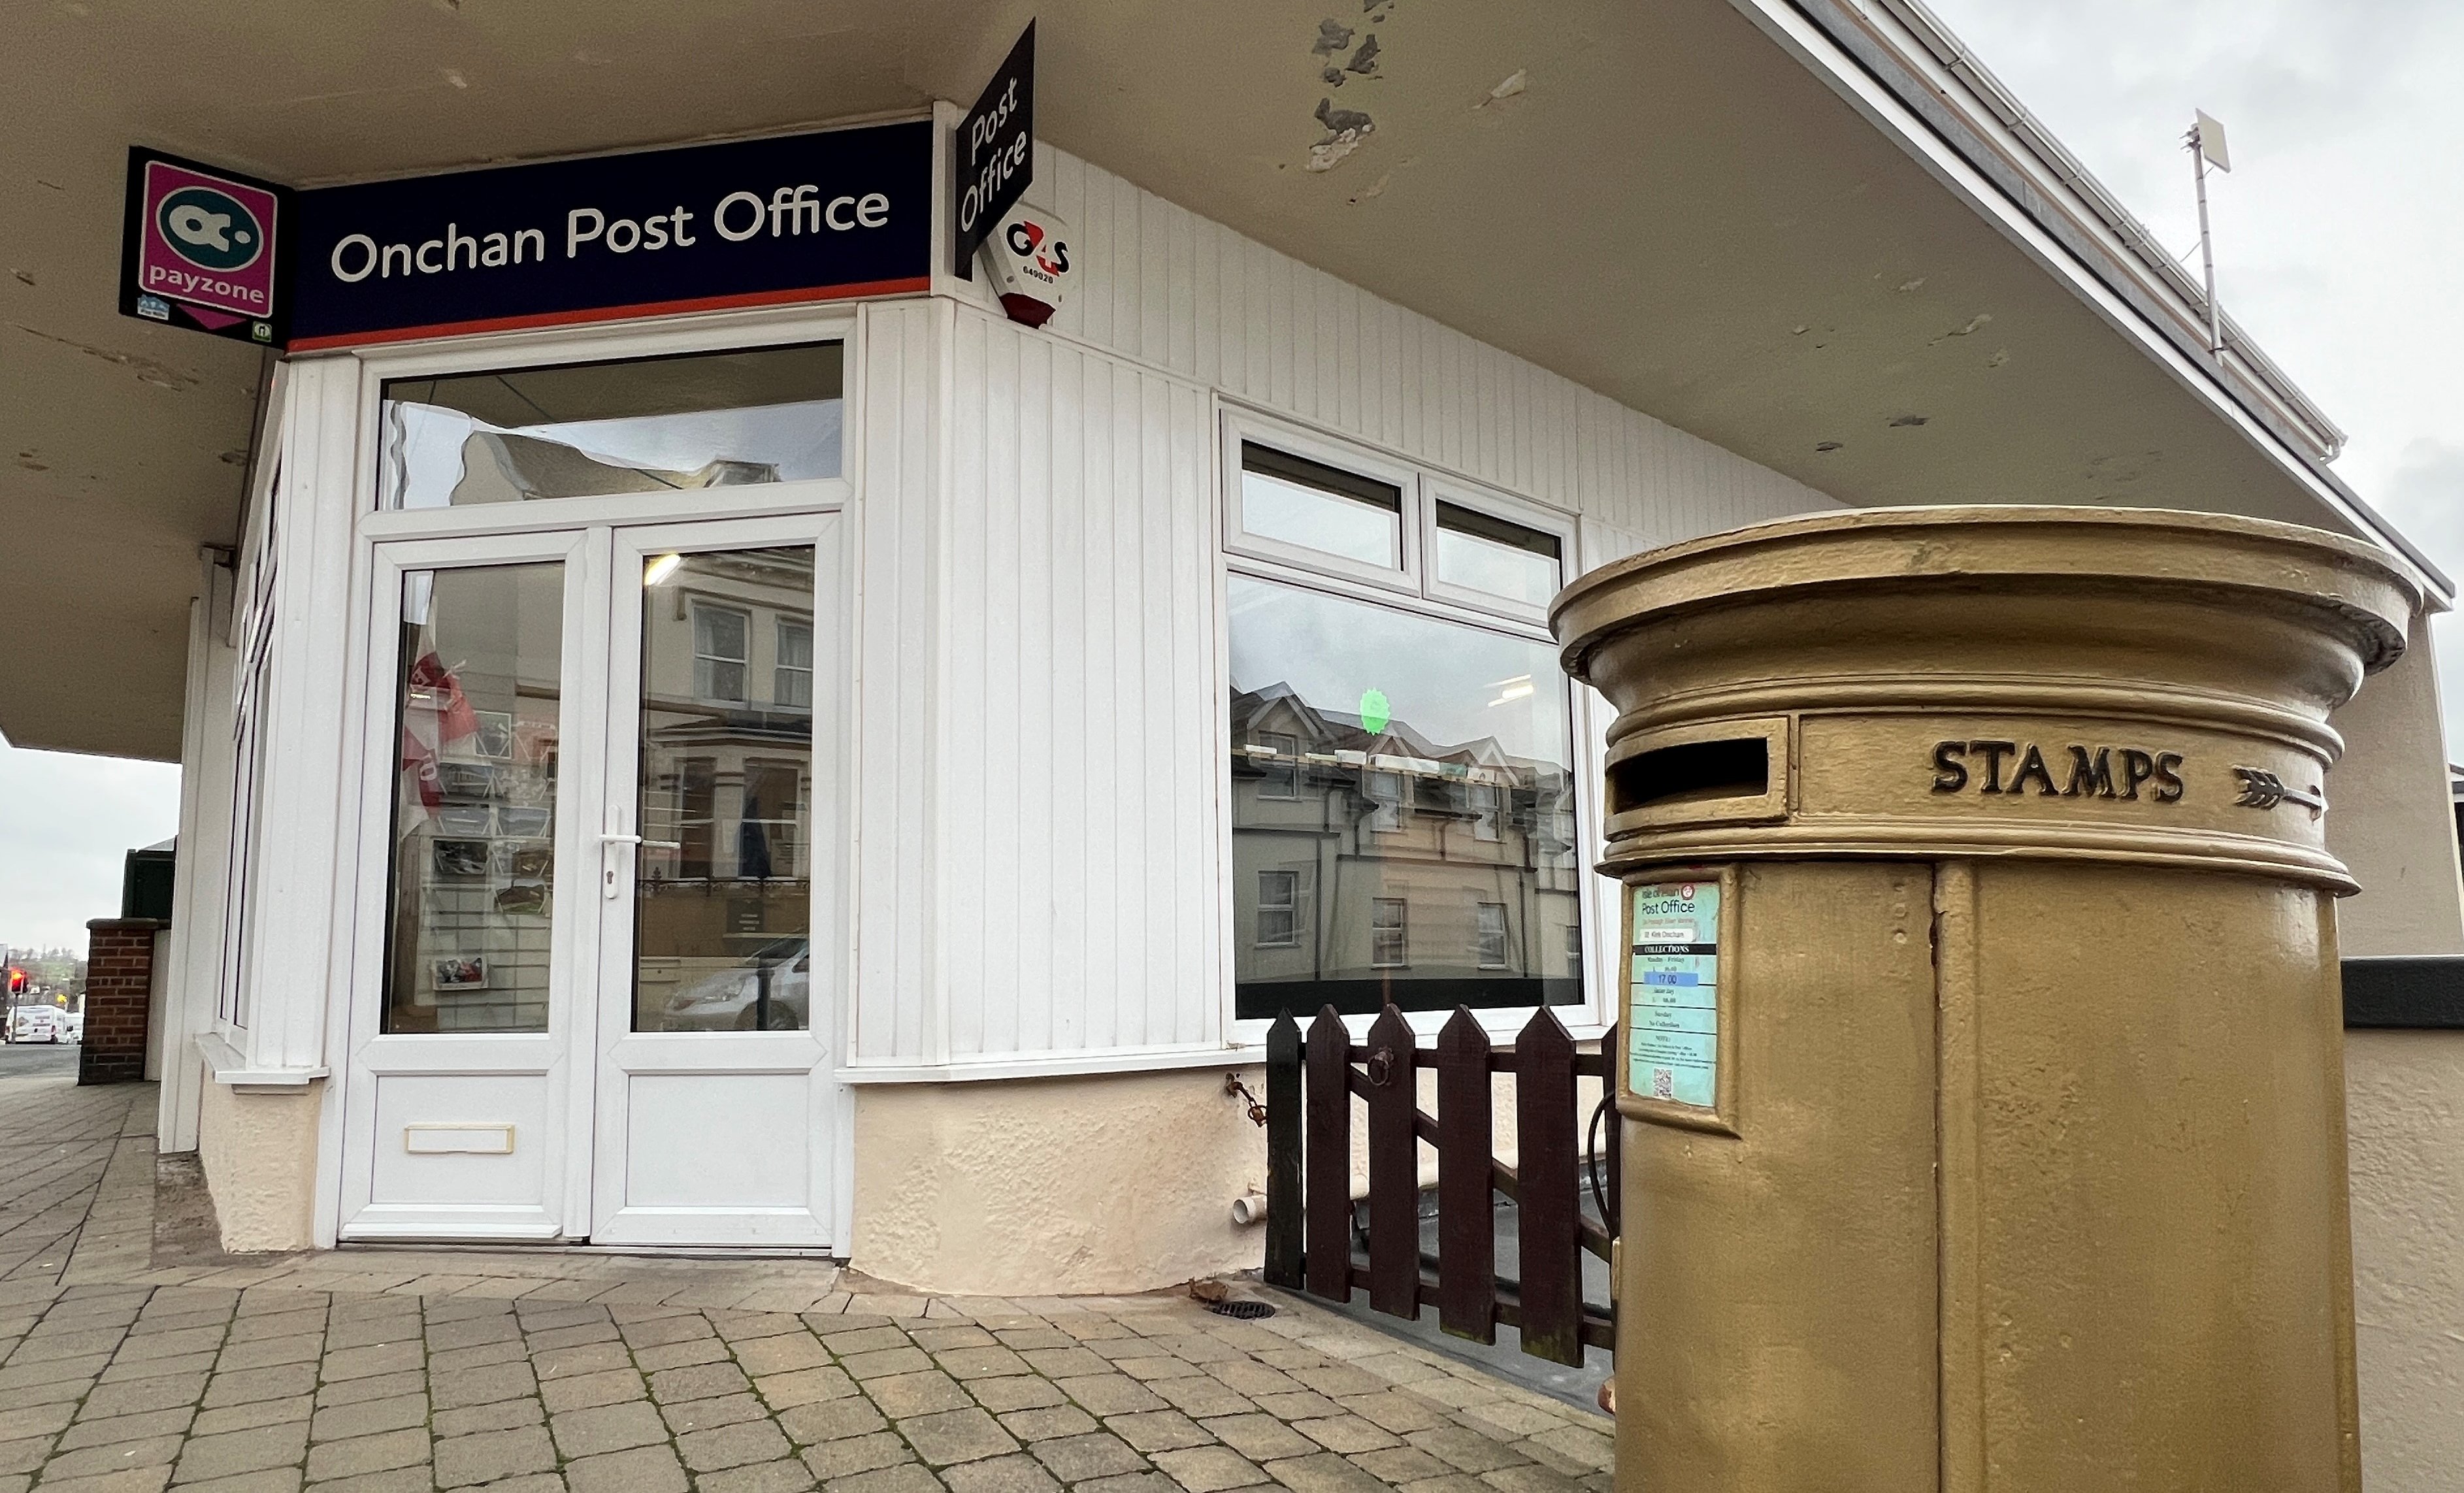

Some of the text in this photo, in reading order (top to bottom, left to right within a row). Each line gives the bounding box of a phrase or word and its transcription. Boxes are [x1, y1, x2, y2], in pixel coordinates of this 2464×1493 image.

[972, 76, 1018, 167] Post
[961, 131, 1027, 233] Office
[331, 184, 889, 282] Onchan Post Office
[1006, 220, 1070, 277] G4S
[149, 265, 265, 304] payzone
[1931, 741, 2183, 802] STAMPS
[1642, 899, 1695, 915] Post Office
[1644, 945, 1690, 953] COLLECTIONS
